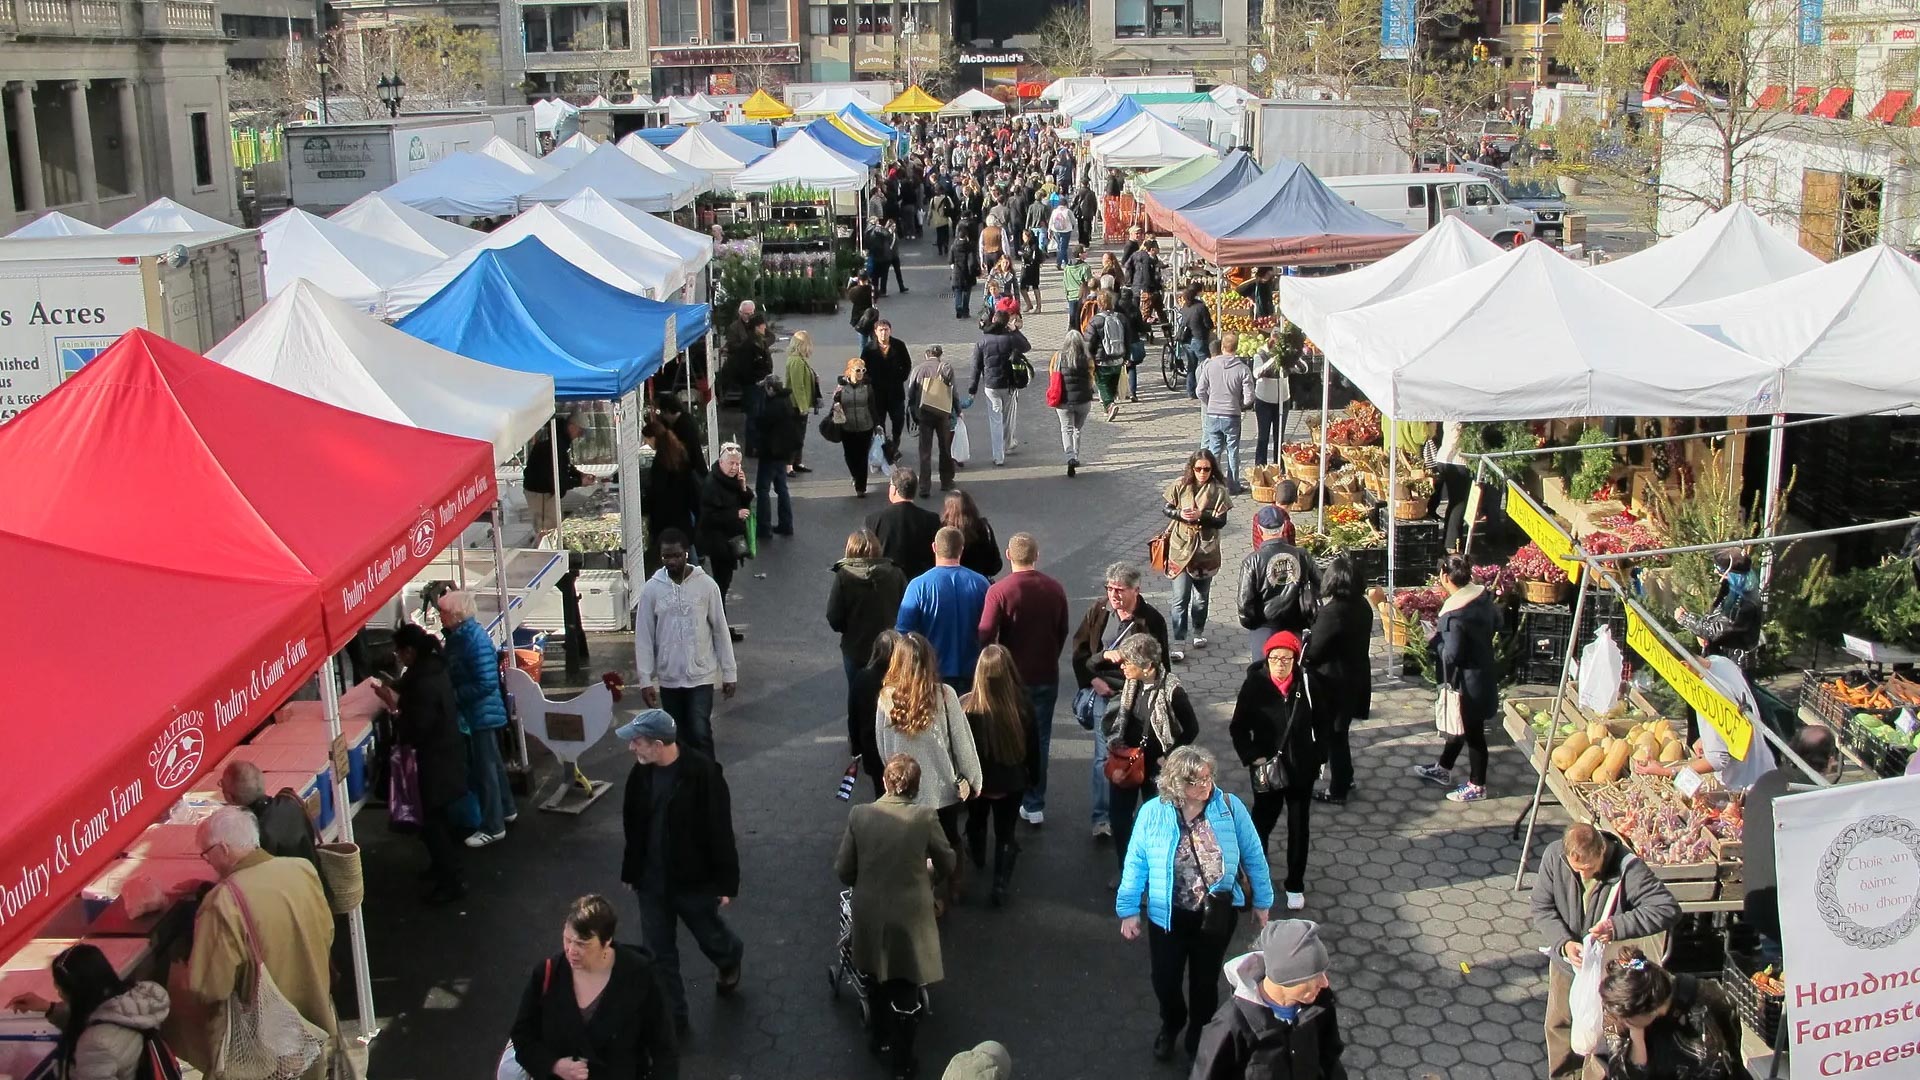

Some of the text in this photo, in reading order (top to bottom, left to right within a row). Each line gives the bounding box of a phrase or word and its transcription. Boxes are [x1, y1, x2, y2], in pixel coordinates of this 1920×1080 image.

[959, 53, 1024, 64] McDonald's
[1893, 28, 1915, 41] petco
[29, 301, 106, 325] Acres
[342, 544, 407, 614] Poultry & Game Farm
[214, 637, 308, 731] Poultry & Game Farm
[1627, 611, 1741, 744] ORGANIC PRODUCE
[148, 710, 205, 768] QUATTRO'S
[0, 778, 144, 925] Poultry & Game Farm
[1819, 1040, 1920, 1077] Chees
